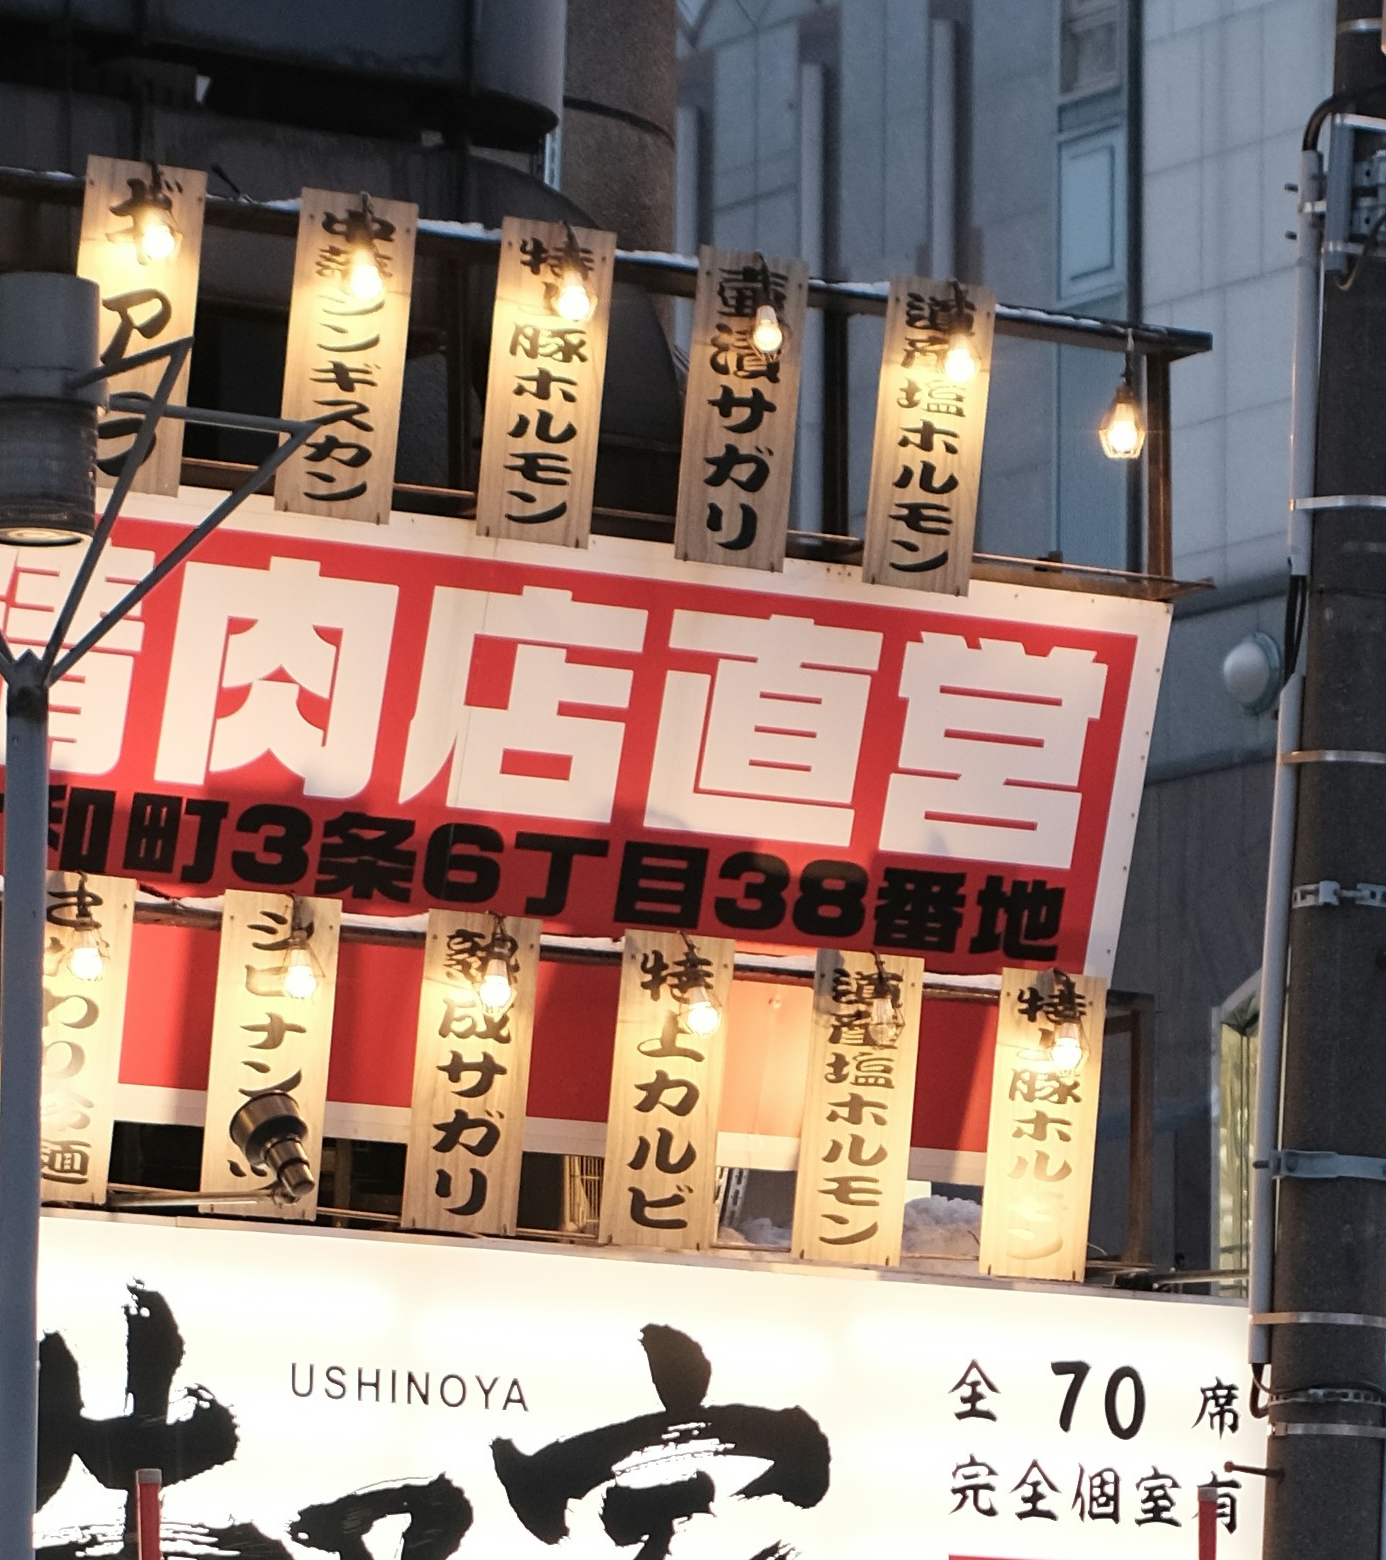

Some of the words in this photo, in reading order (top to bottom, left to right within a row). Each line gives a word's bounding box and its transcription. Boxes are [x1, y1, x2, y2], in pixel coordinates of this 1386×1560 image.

[290, 1361, 529, 1413] USHINOYA
[949, 1453, 1244, 1535] 完全個室有
